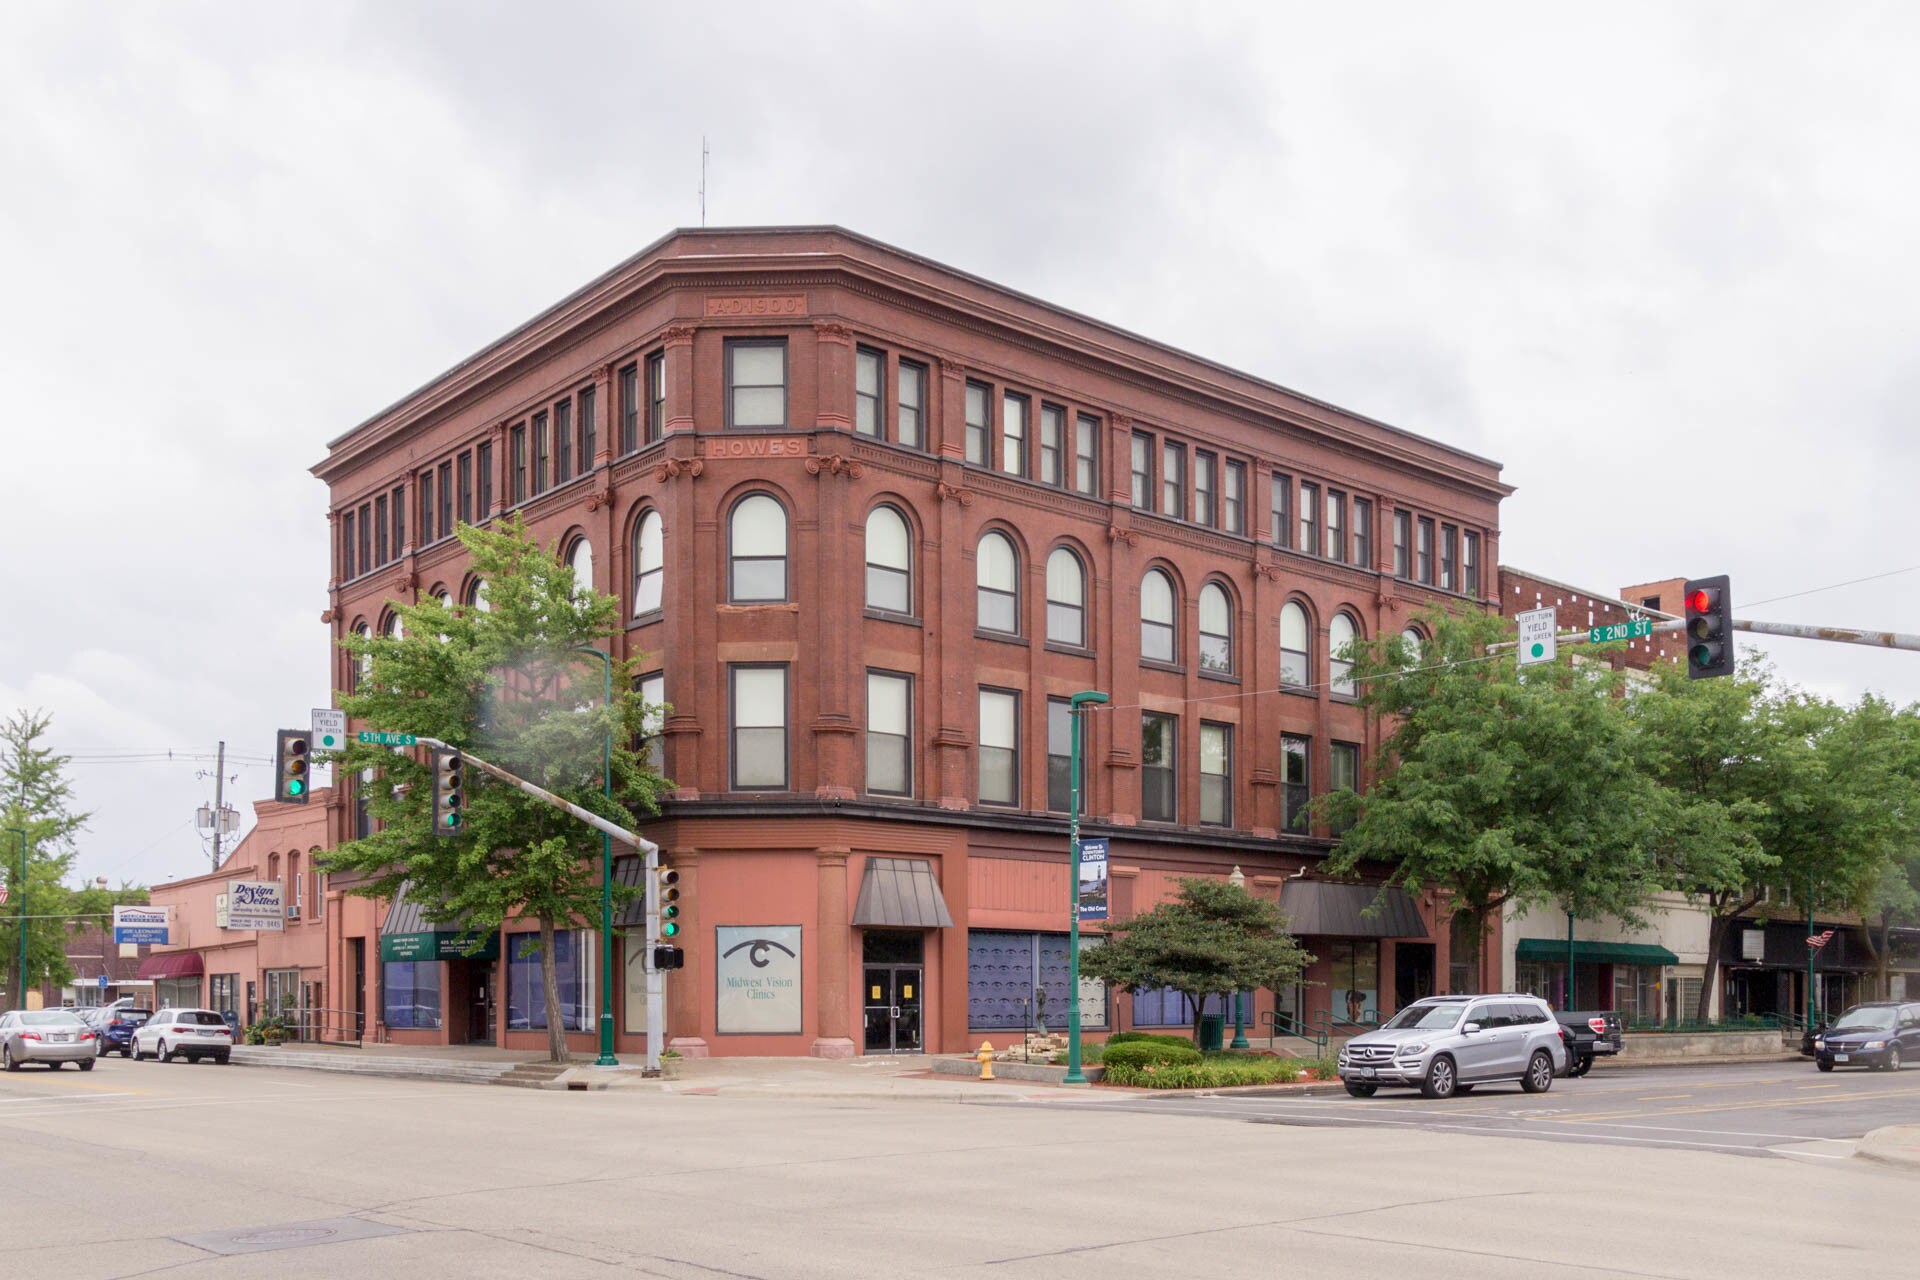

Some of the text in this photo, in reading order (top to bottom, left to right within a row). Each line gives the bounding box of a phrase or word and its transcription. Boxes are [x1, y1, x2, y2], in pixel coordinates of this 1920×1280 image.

[712, 439, 801, 456] HOWES
[1521, 611, 1553, 623] LEFT TURN
[1527, 622, 1548, 632] YIELD
[1593, 621, 1648, 641] S 2ND ST
[1533, 632, 1552, 640] GREEN
[363, 732, 412, 744] 5TH AVE S
[1082, 853, 1105, 861] CLINTON
[234, 884, 274, 897] Design
[727, 977, 793, 987] Midwest Vision
[746, 988, 775, 1000] Clinics
